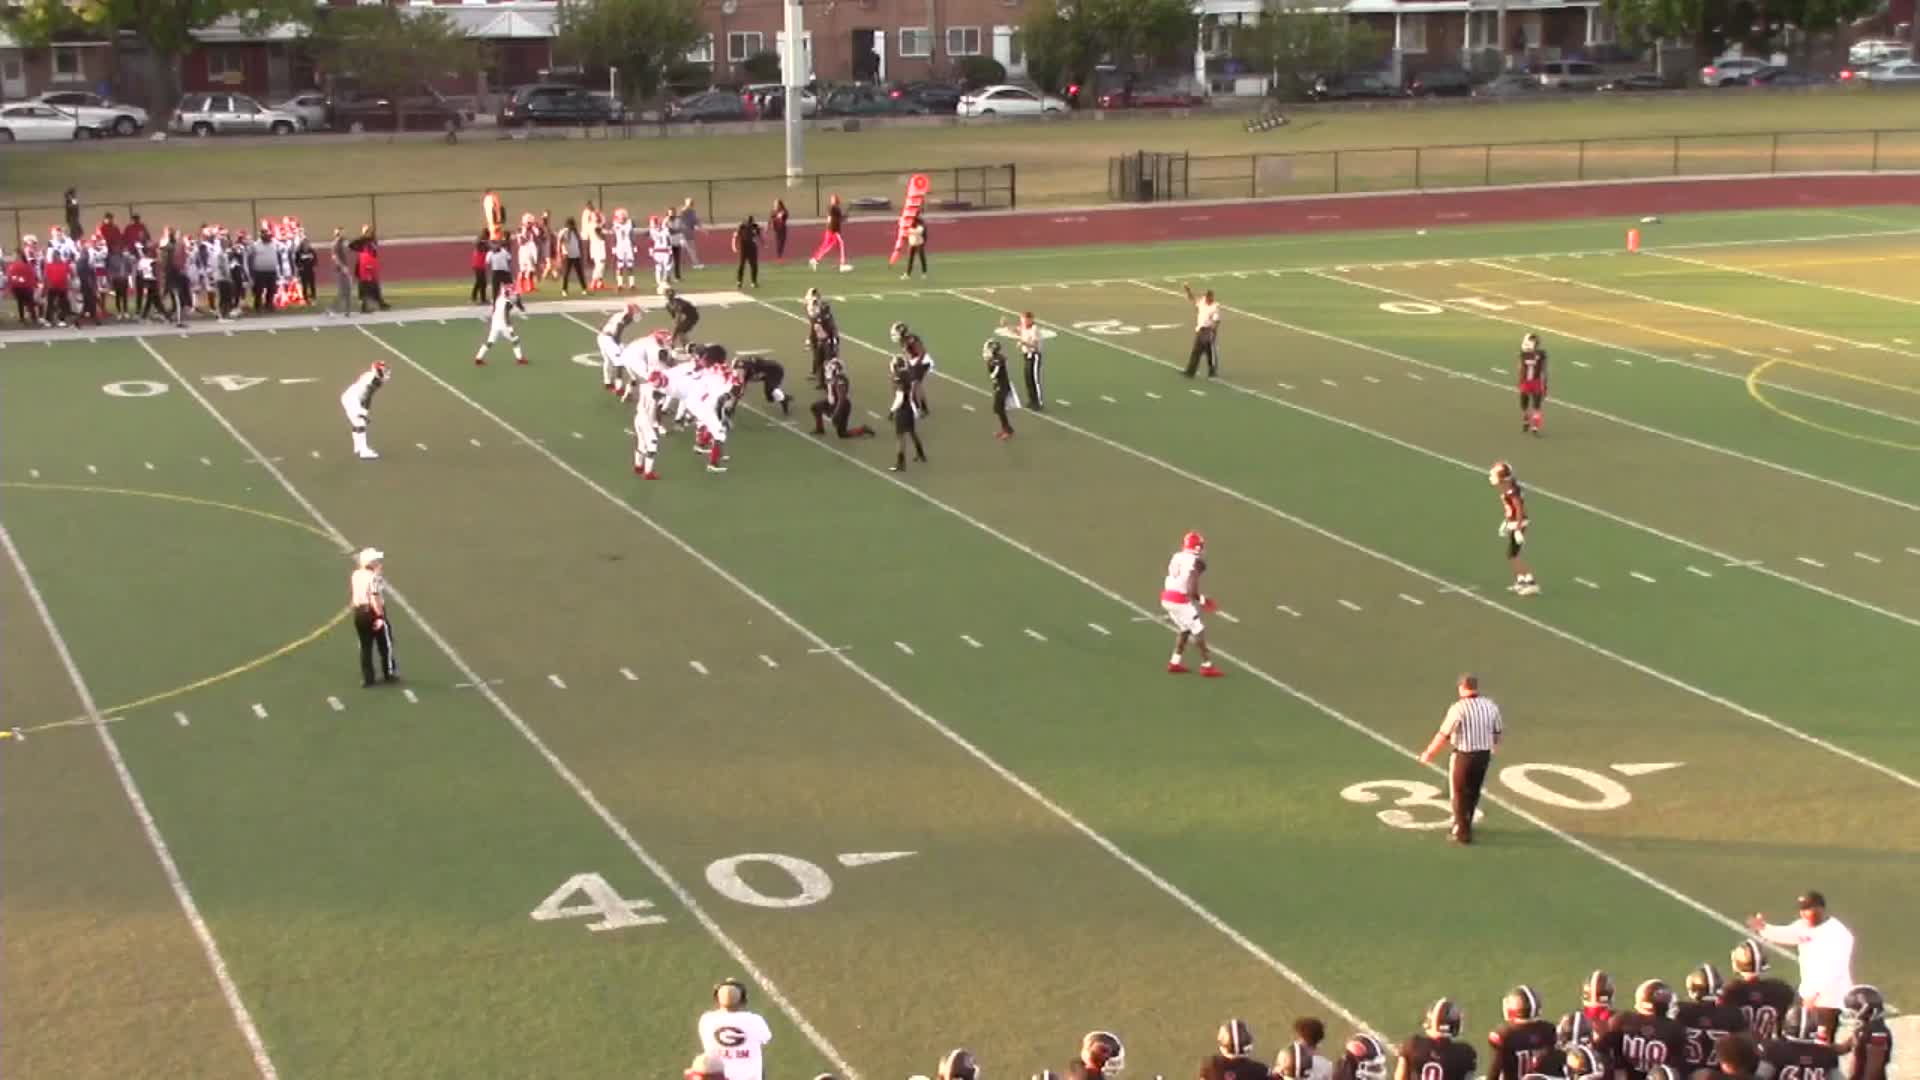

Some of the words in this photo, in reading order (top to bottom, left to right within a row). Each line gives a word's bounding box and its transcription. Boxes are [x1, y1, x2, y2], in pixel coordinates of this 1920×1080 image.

[1340, 763, 1631, 829] 30
[530, 853, 832, 931] 40
[714, 1027, 747, 1047] G
